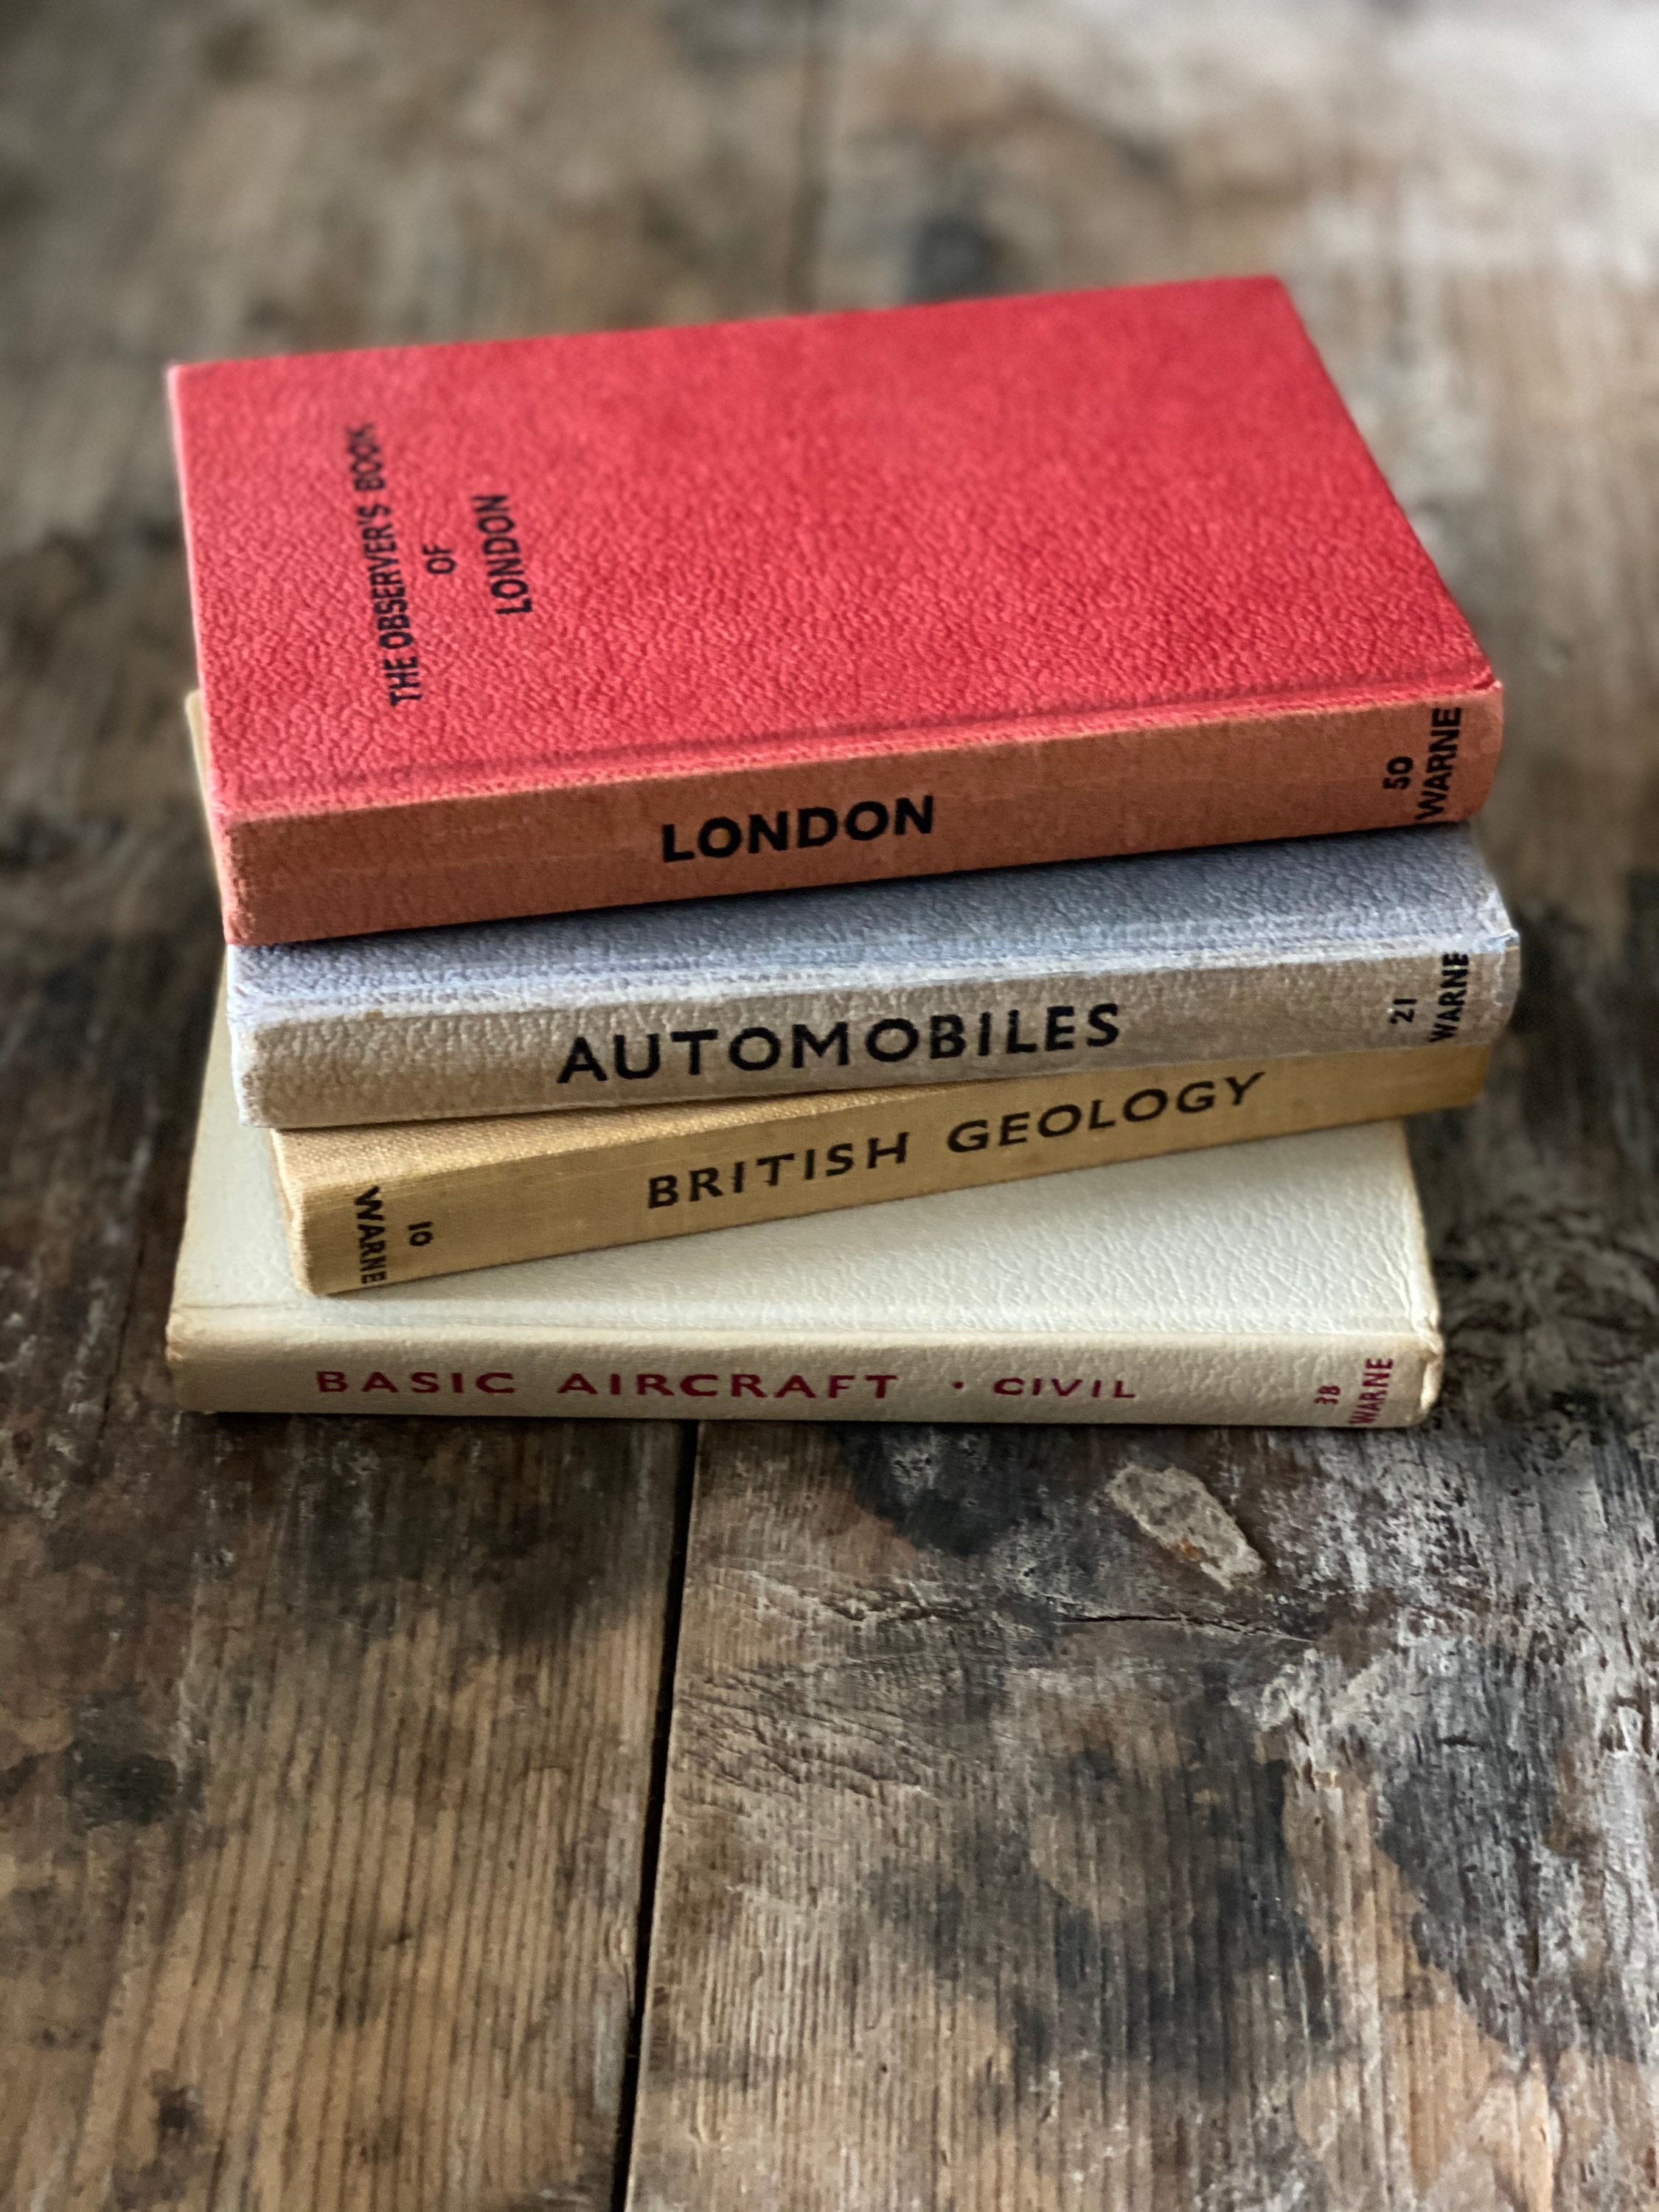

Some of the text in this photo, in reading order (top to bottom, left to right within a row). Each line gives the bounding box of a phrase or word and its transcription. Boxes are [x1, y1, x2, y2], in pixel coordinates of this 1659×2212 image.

[345, 423, 422, 706] THE OBSERVER'S BOOK
[422, 544, 457, 575] OF
[472, 495, 533, 615] LONDON
[1383, 756, 1414, 790] 50
[1416, 706, 1462, 821] WARNE
[661, 795, 934, 863] LONDON
[1390, 998, 1417, 1024] 21
[1428, 951, 1470, 1043] WARNE
[557, 1004, 1120, 1084] AUTOMOBILES
[647, 1071, 1265, 1210] BRITISH GEOLOGY
[354, 1186, 387, 1284] WARNE
[408, 1221, 434, 1247] 10
[316, 1371, 515, 1394] BASIC
[557, 1372, 898, 1399] AIRCRAFT
[993, 1377, 1136, 1399] CIVIL
[1348, 1358, 1394, 1425] WARNE
